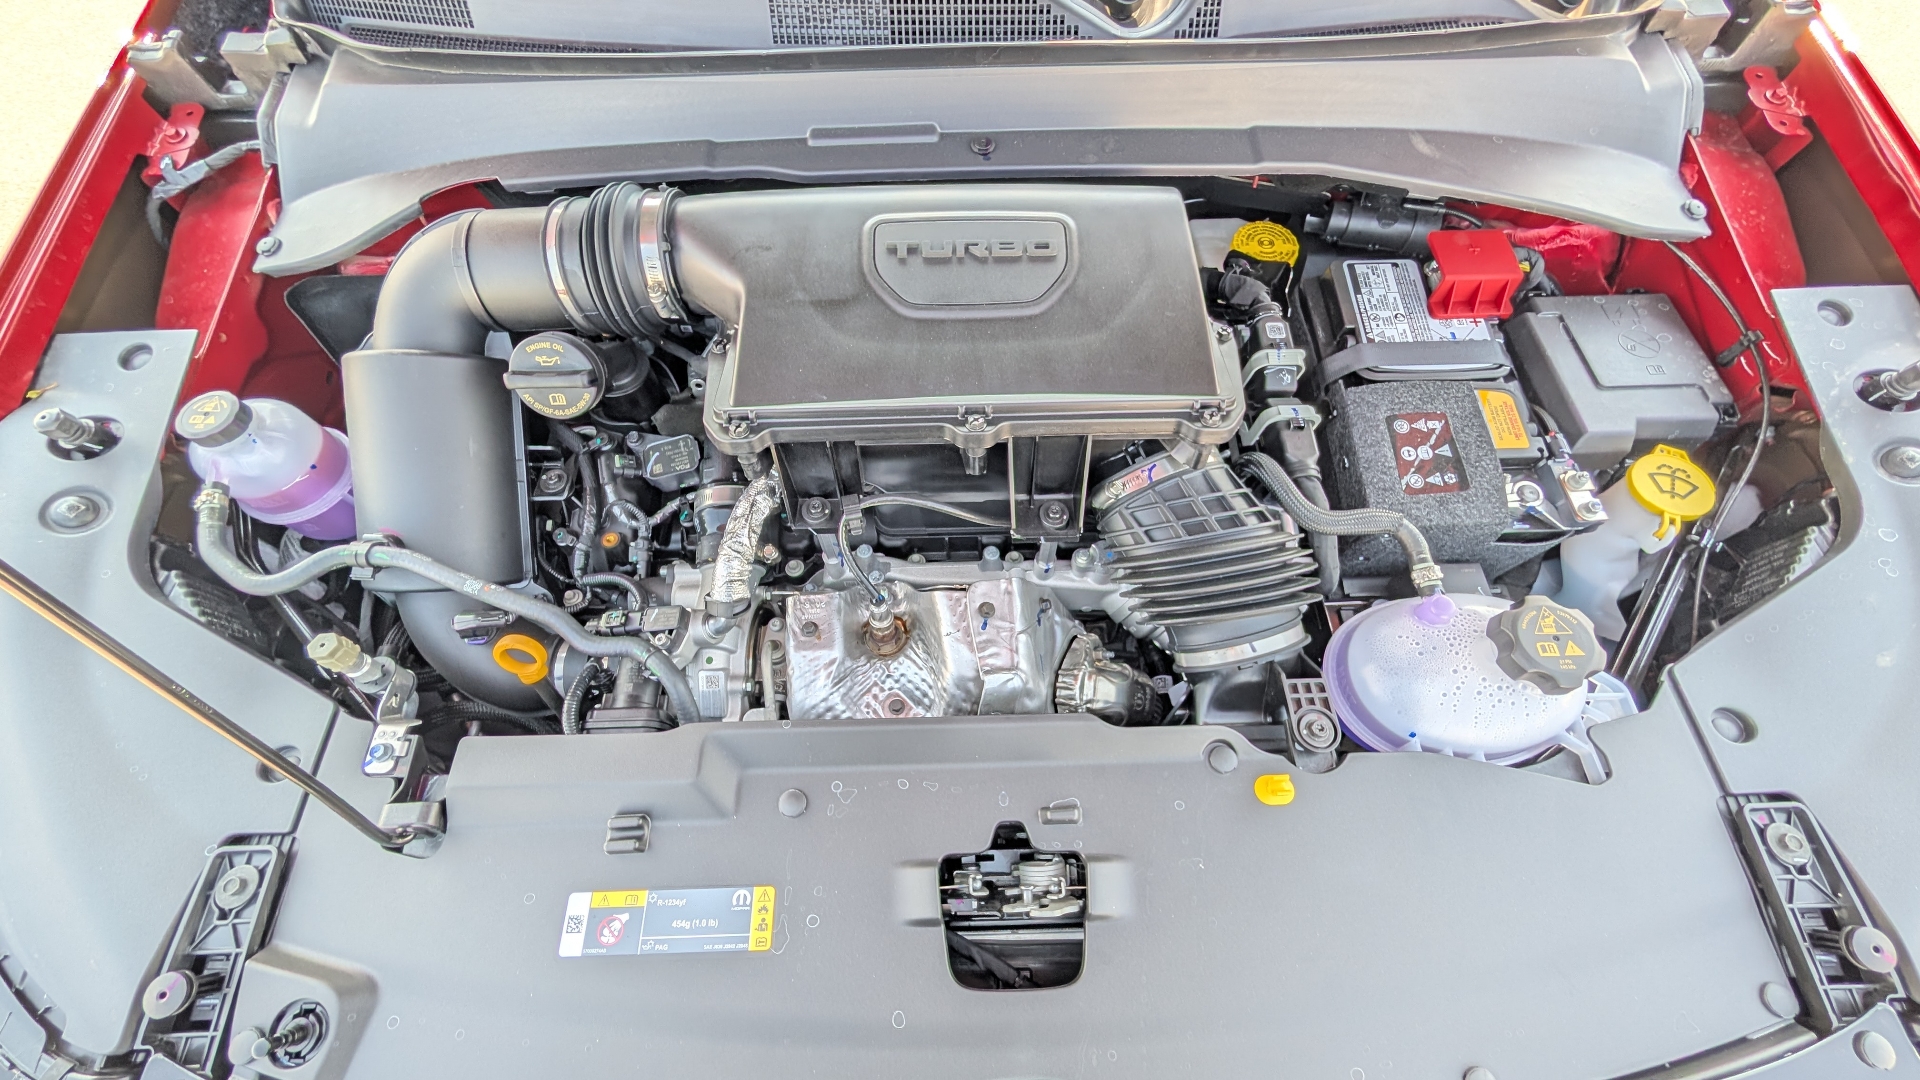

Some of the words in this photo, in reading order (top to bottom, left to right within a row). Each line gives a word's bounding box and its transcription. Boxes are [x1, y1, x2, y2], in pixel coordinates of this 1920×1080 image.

[885, 240, 1057, 258] TURBO
[526, 342, 551, 353] ENGINE
[552, 343, 564, 352] OIL
[523, 393, 534, 405] API
[657, 899, 686, 907] R-1234yf
[672, 919, 690, 929] 454g
[692, 919, 706, 929] (1.0
[708, 918, 718, 928] lb)
